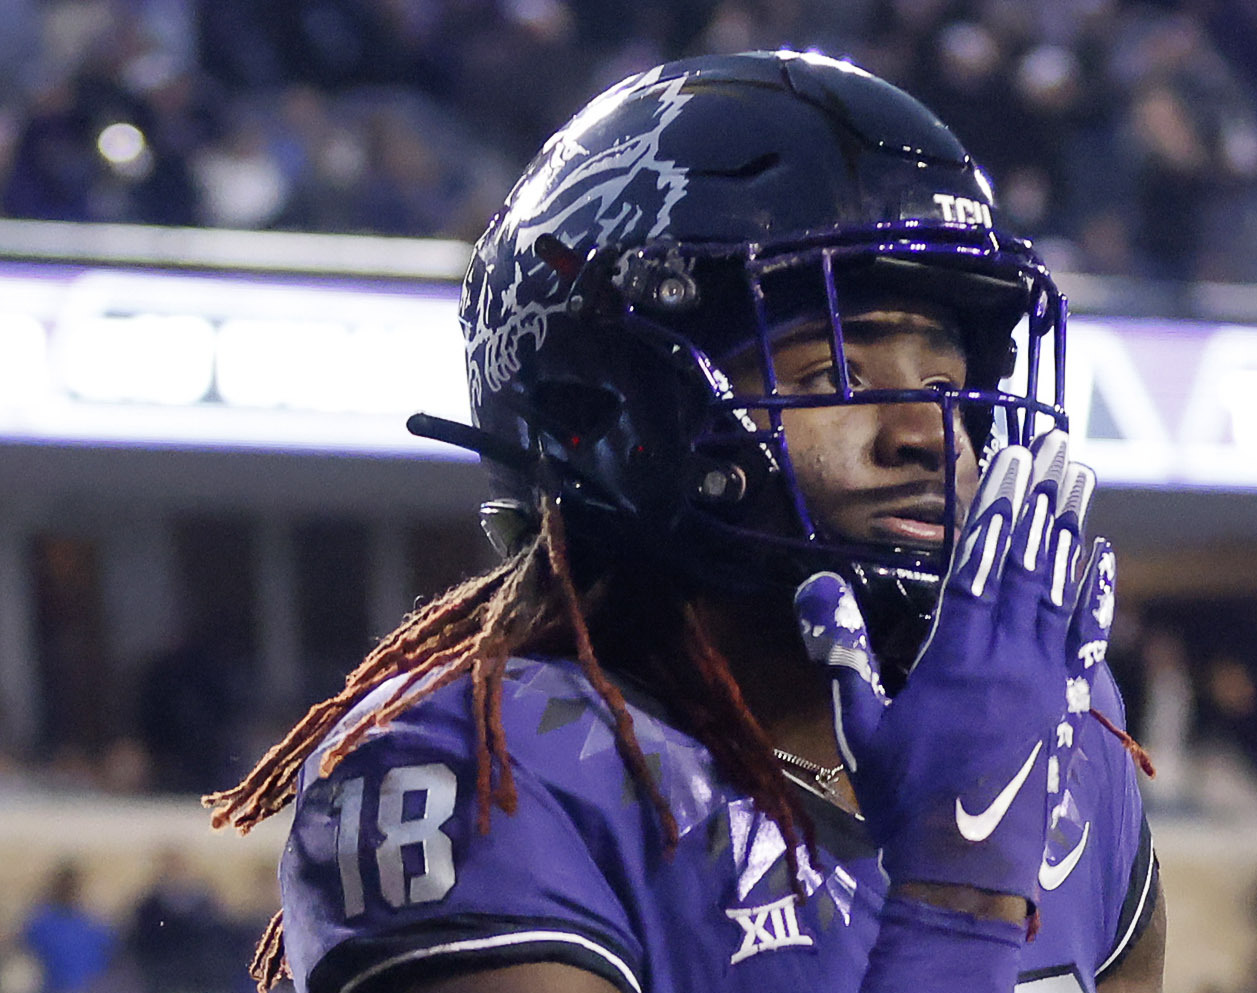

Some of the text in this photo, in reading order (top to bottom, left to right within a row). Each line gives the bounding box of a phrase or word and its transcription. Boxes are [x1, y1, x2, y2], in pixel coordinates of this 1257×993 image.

[933, 193, 993, 229] TCU
[333, 762, 459, 919] 18
[724, 894, 814, 965] XII
